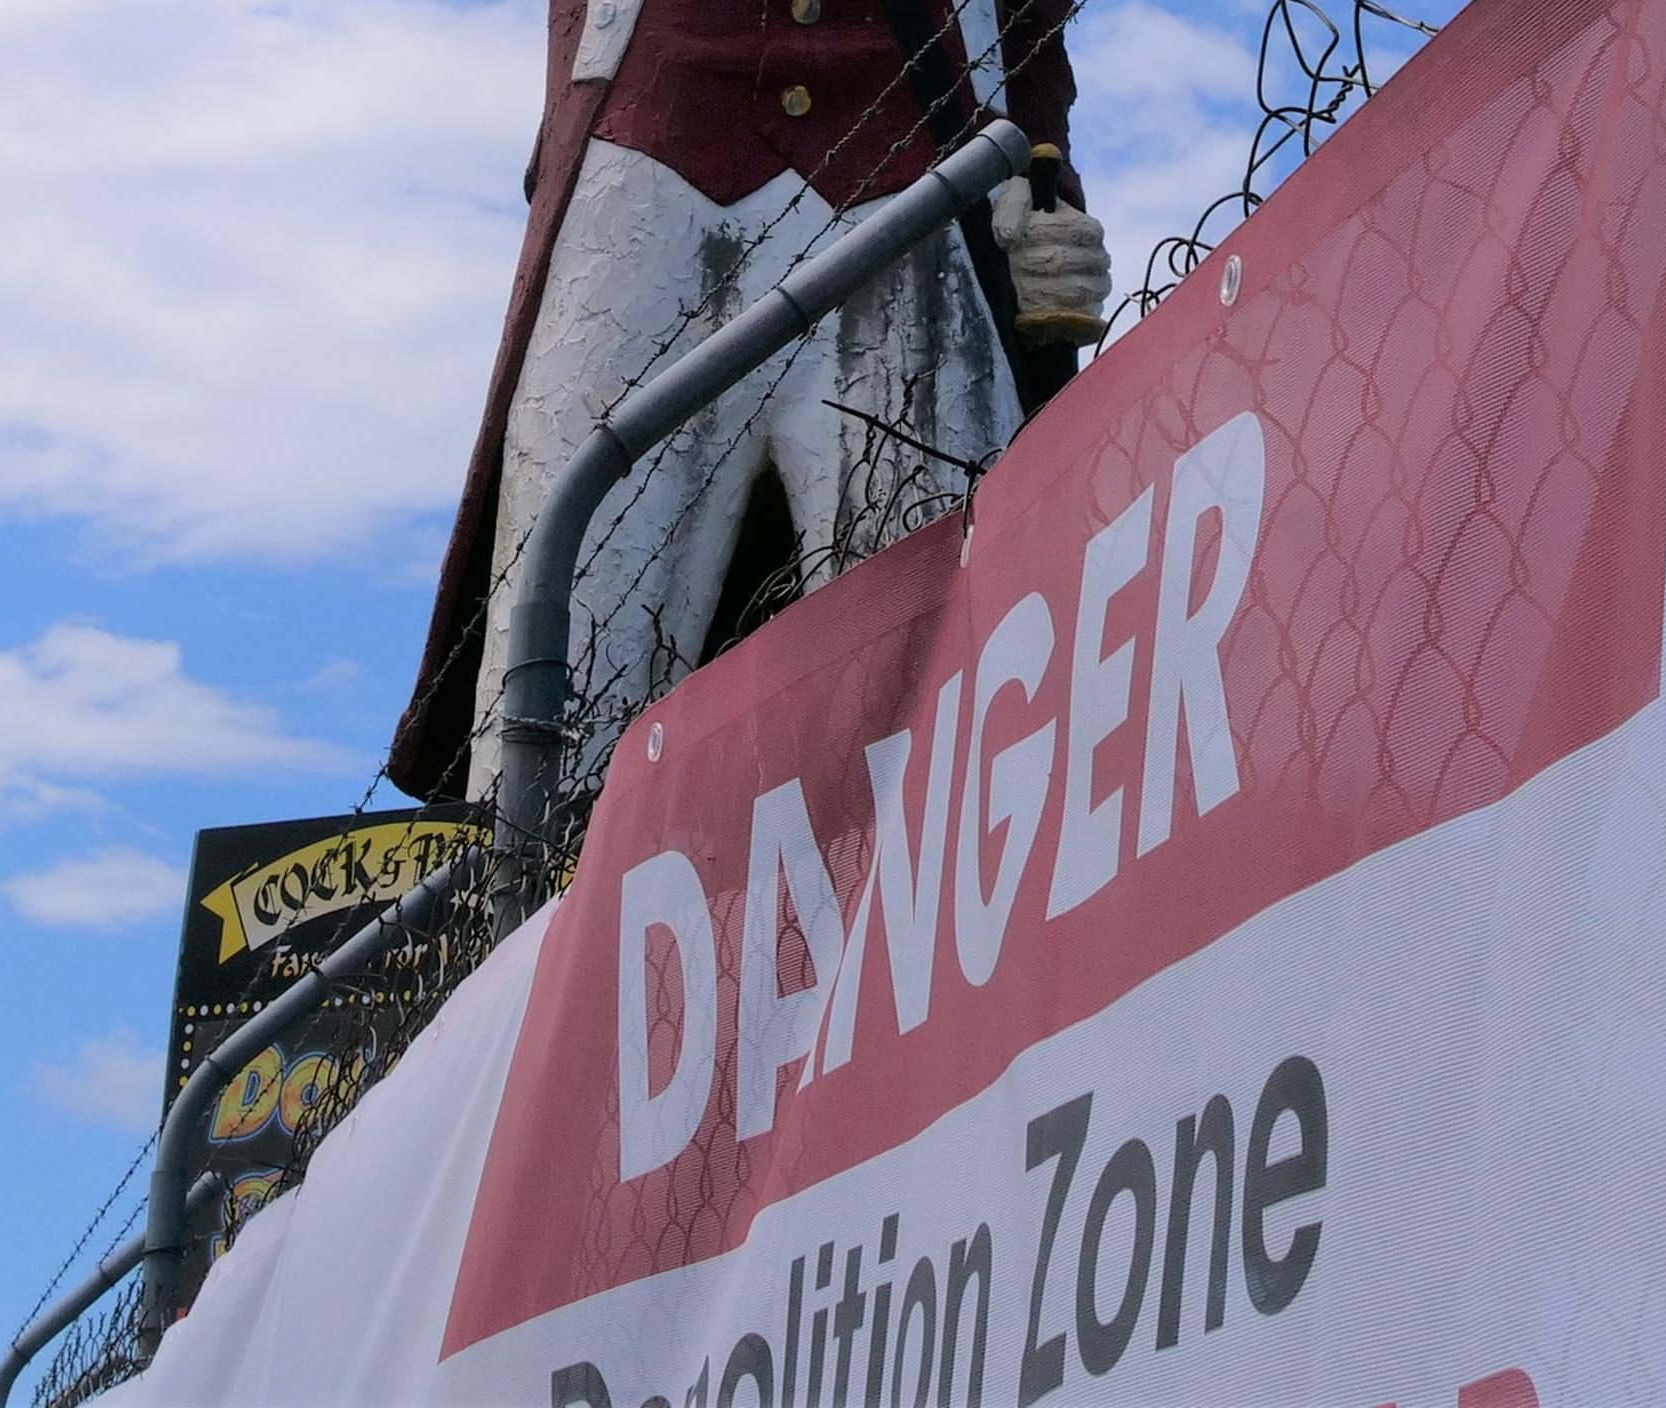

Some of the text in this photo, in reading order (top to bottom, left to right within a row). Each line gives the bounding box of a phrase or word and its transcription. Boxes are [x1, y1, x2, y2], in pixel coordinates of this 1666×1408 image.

[252, 838, 378, 926] COCK
[618, 410, 1266, 1184] DANGER
[1017, 1054, 1329, 1408] Zone
